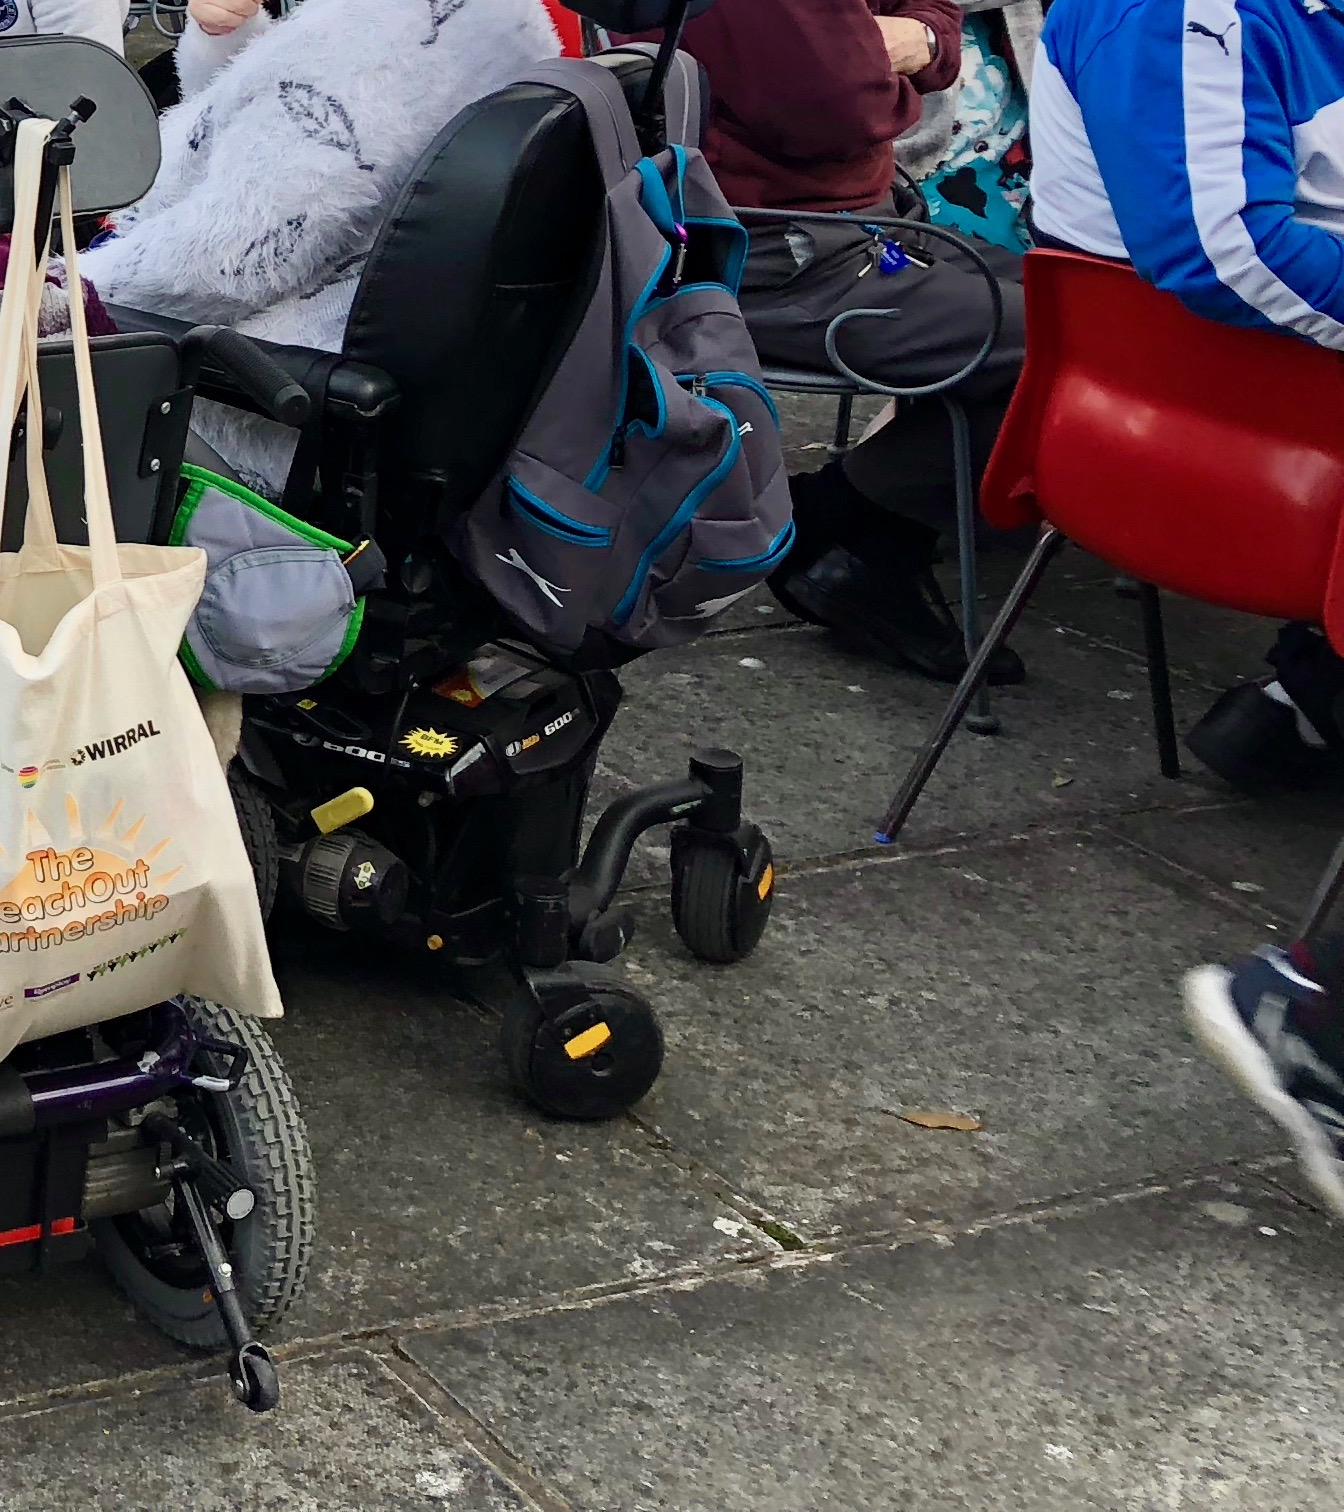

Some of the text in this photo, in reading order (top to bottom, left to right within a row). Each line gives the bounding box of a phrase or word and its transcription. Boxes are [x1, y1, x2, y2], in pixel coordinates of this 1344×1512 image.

[84, 719, 161, 762] WIRRAL
[543, 711, 573, 737] 600
[25, 846, 95, 883] The
